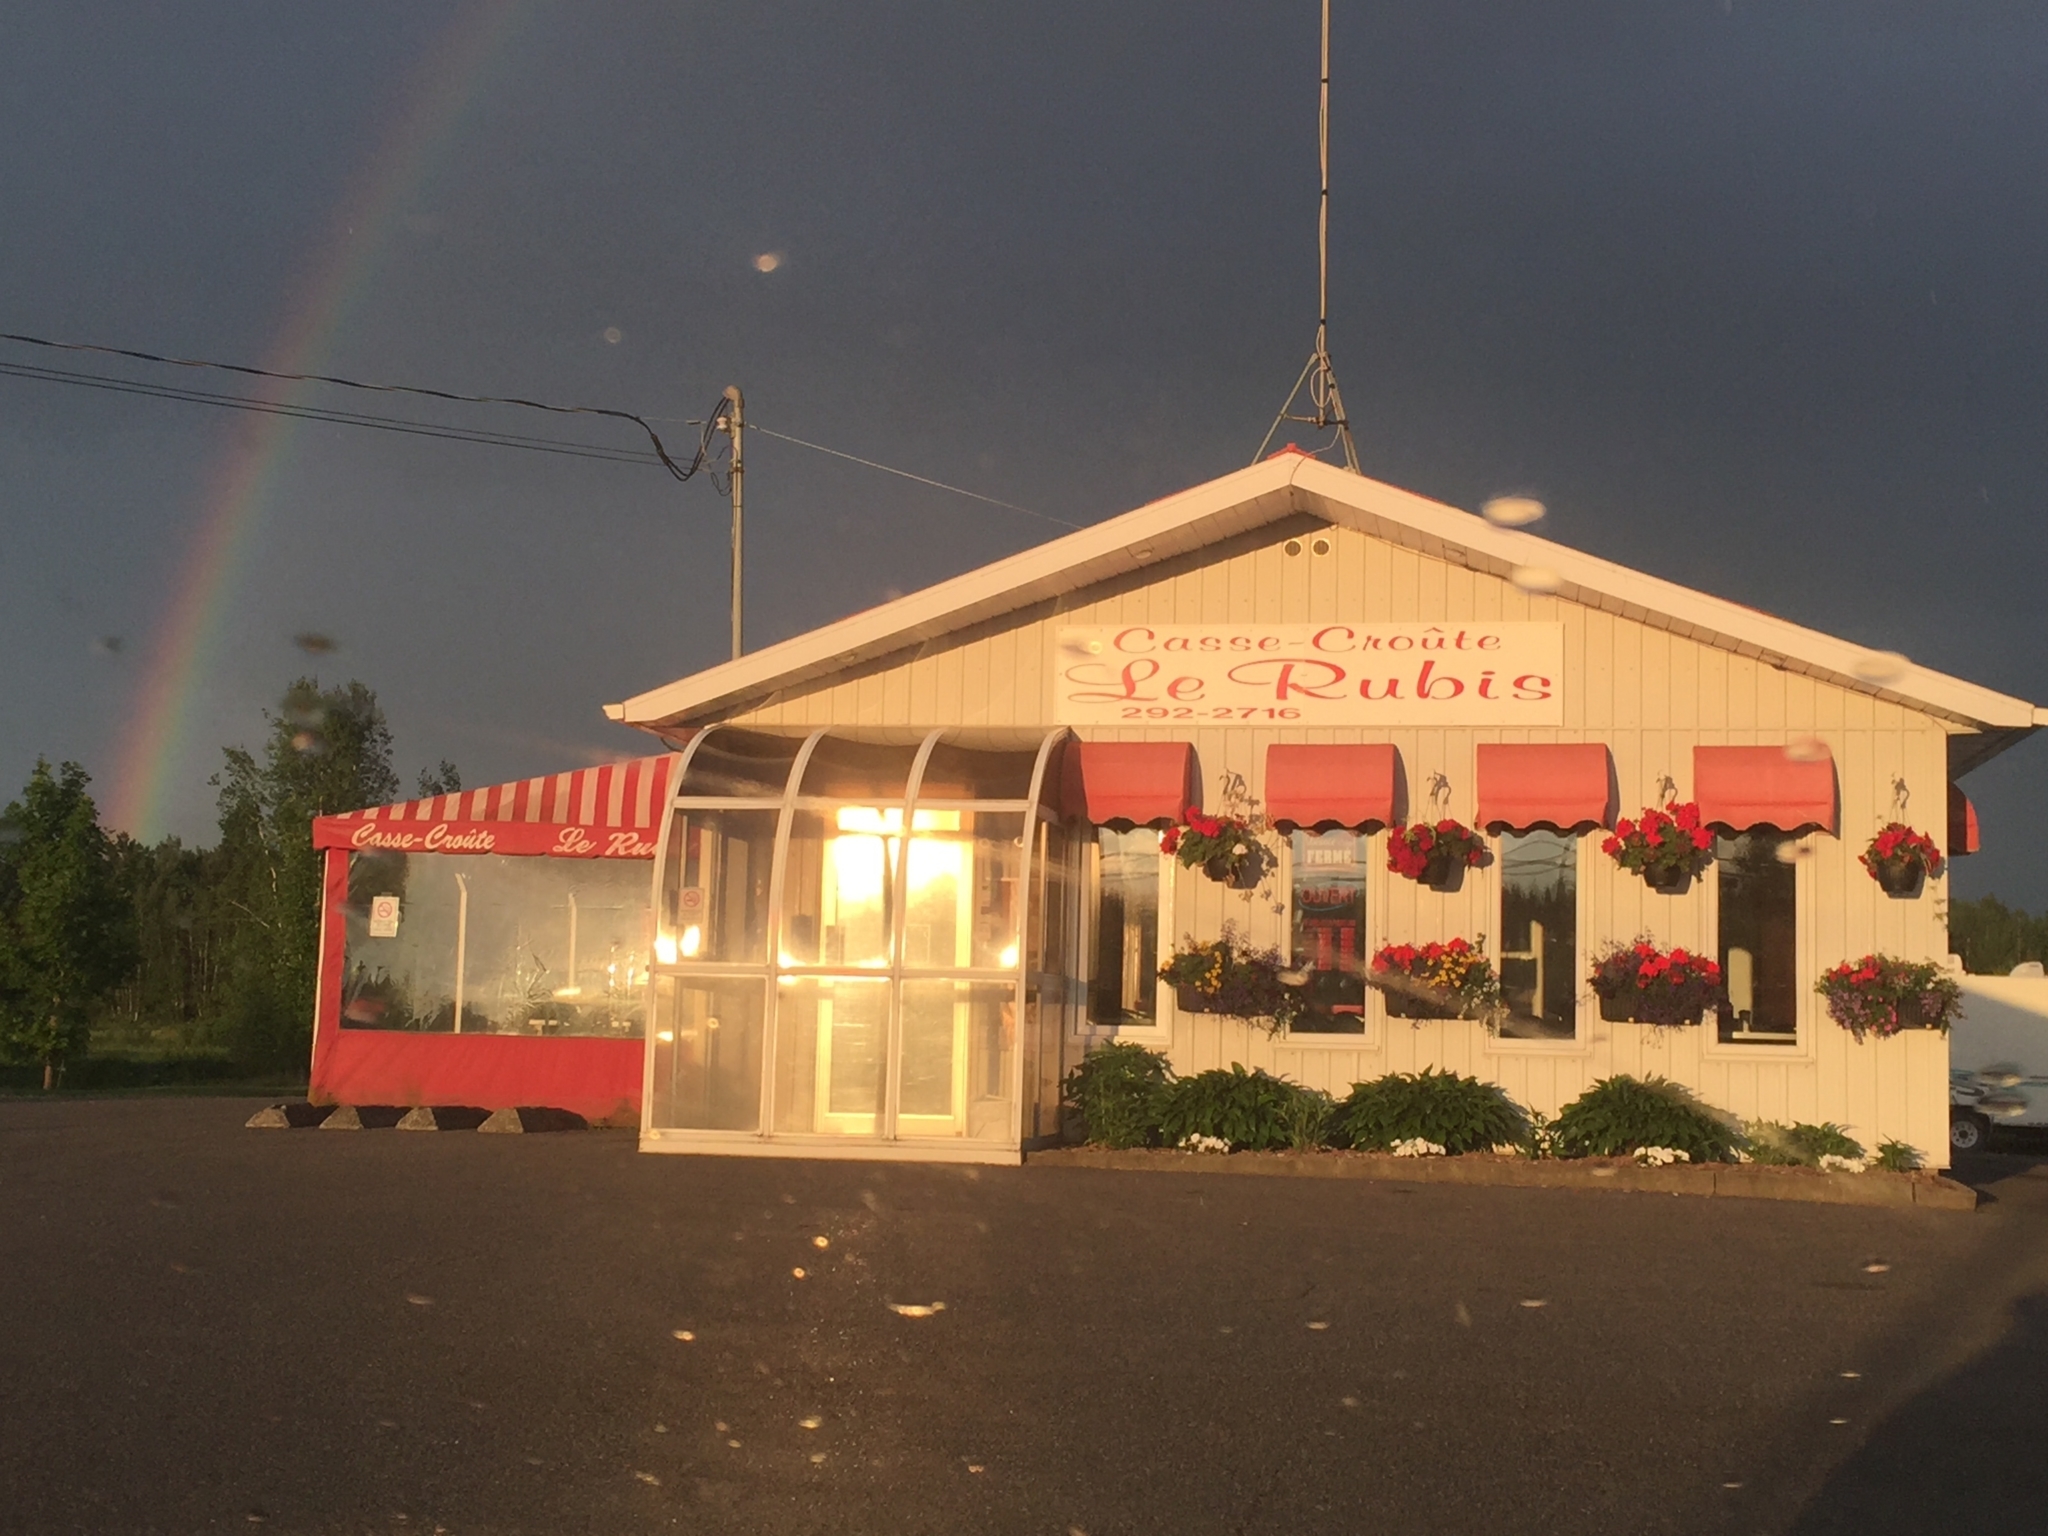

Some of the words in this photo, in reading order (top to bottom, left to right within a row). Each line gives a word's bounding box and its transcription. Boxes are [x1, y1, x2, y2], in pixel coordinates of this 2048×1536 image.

[1114, 627, 1501, 653] Casse-Croûte
[1065, 658, 1205, 703] Le
[1227, 658, 1552, 700] Rubis
[1121, 707, 1301, 719] 292-2716
[351, 822, 496, 850] Casse-Croûte
[552, 827, 598, 853] Le
[604, 832, 659, 856] Ru
[1301, 887, 1356, 904] OUVERT
